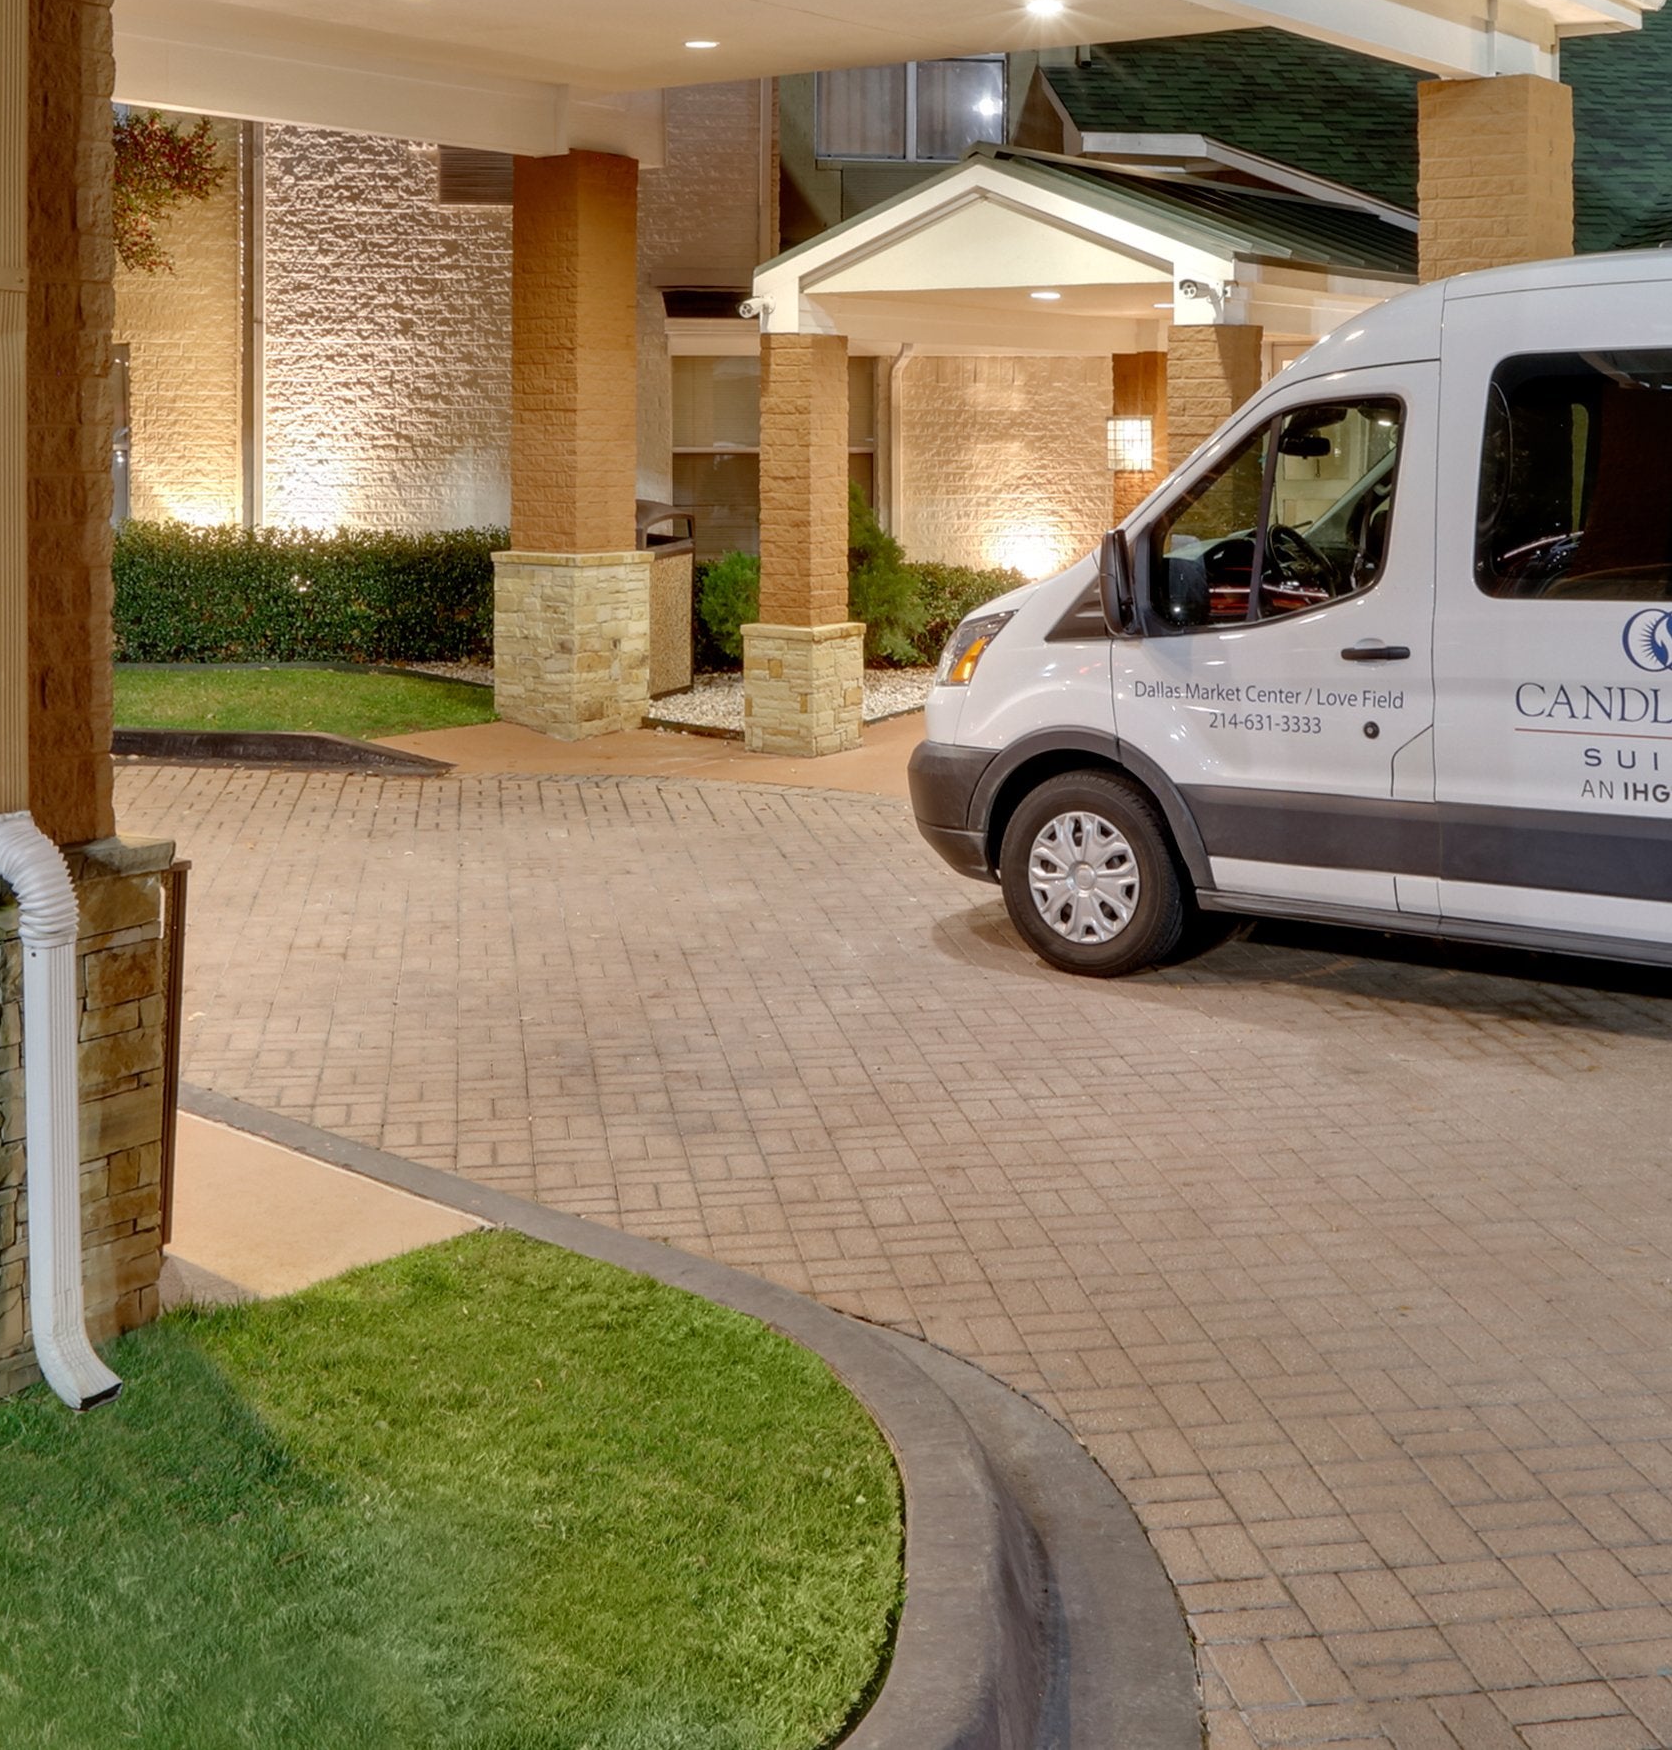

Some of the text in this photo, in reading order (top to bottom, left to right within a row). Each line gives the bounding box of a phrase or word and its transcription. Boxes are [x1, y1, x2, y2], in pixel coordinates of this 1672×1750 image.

[1134, 681, 1404, 709] Dallas Market Center / Love Field
[1209, 712, 1322, 734] 214-631-3333
[1581, 779, 1615, 800] AN
